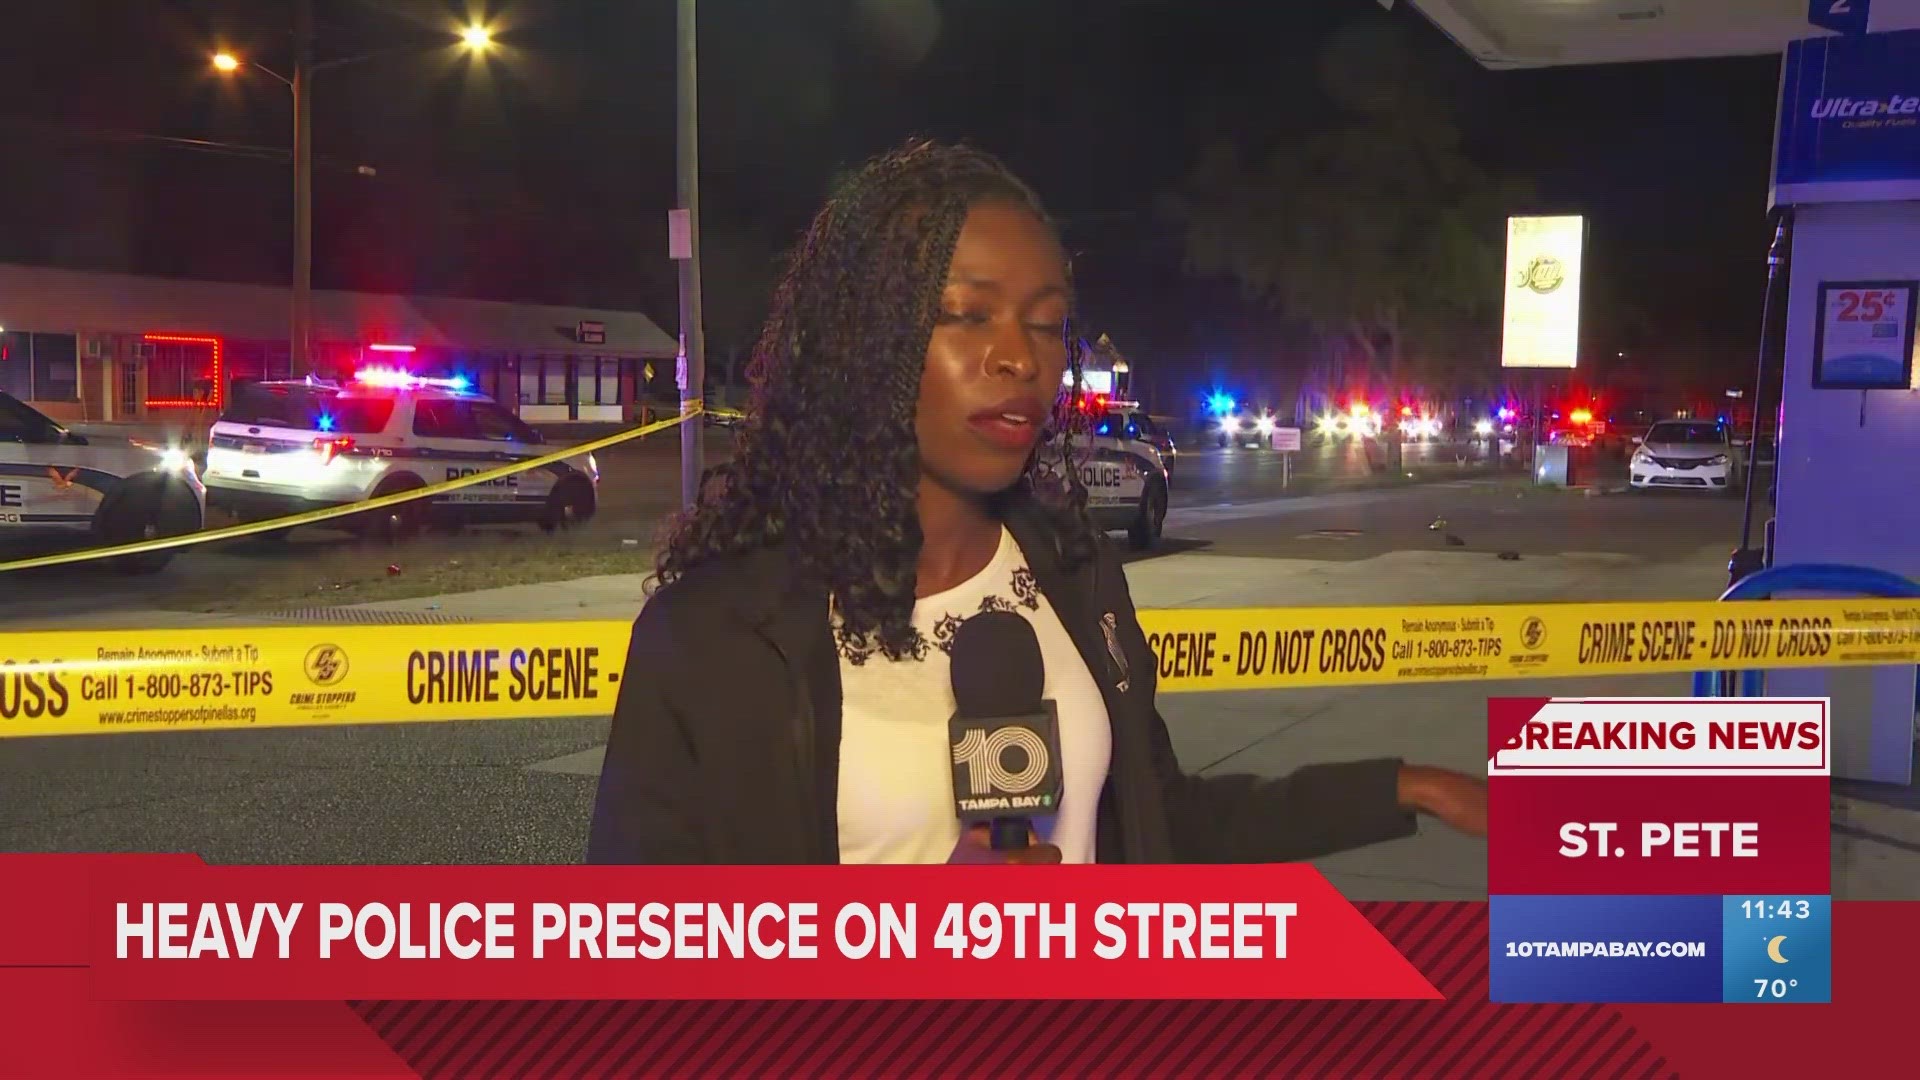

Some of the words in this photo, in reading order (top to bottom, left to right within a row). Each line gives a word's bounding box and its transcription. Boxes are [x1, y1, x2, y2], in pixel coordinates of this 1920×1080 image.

[1810, 97, 1879, 118] Ultra
[1886, 94, 1920, 114] te
[201, 644, 234, 662] Submit
[243, 644, 259, 664] Tip
[1236, 630, 1268, 676] DO
[1271, 630, 1315, 675] NOT
[1319, 628, 1387, 674] CROSS
[1392, 639, 1413, 660] Call
[1417, 637, 1502, 659] 1-800-873-TIPS
[1578, 621, 1636, 665] CRIME
[1638, 621, 1696, 663] SCENE
[1710, 619, 1737, 661] DO
[1738, 619, 1774, 660] NOT
[1776, 617, 1833, 659] CROSS
[81, 674, 118, 701] Call
[125, 671, 273, 699] 1-800-873-TIPS
[407, 649, 500, 704] CRIME
[508, 647, 599, 701] SCENE
[952, 726, 1049, 795] 10
[959, 797, 1010, 811] TAMPA
[1011, 794, 1041, 808] BAY
